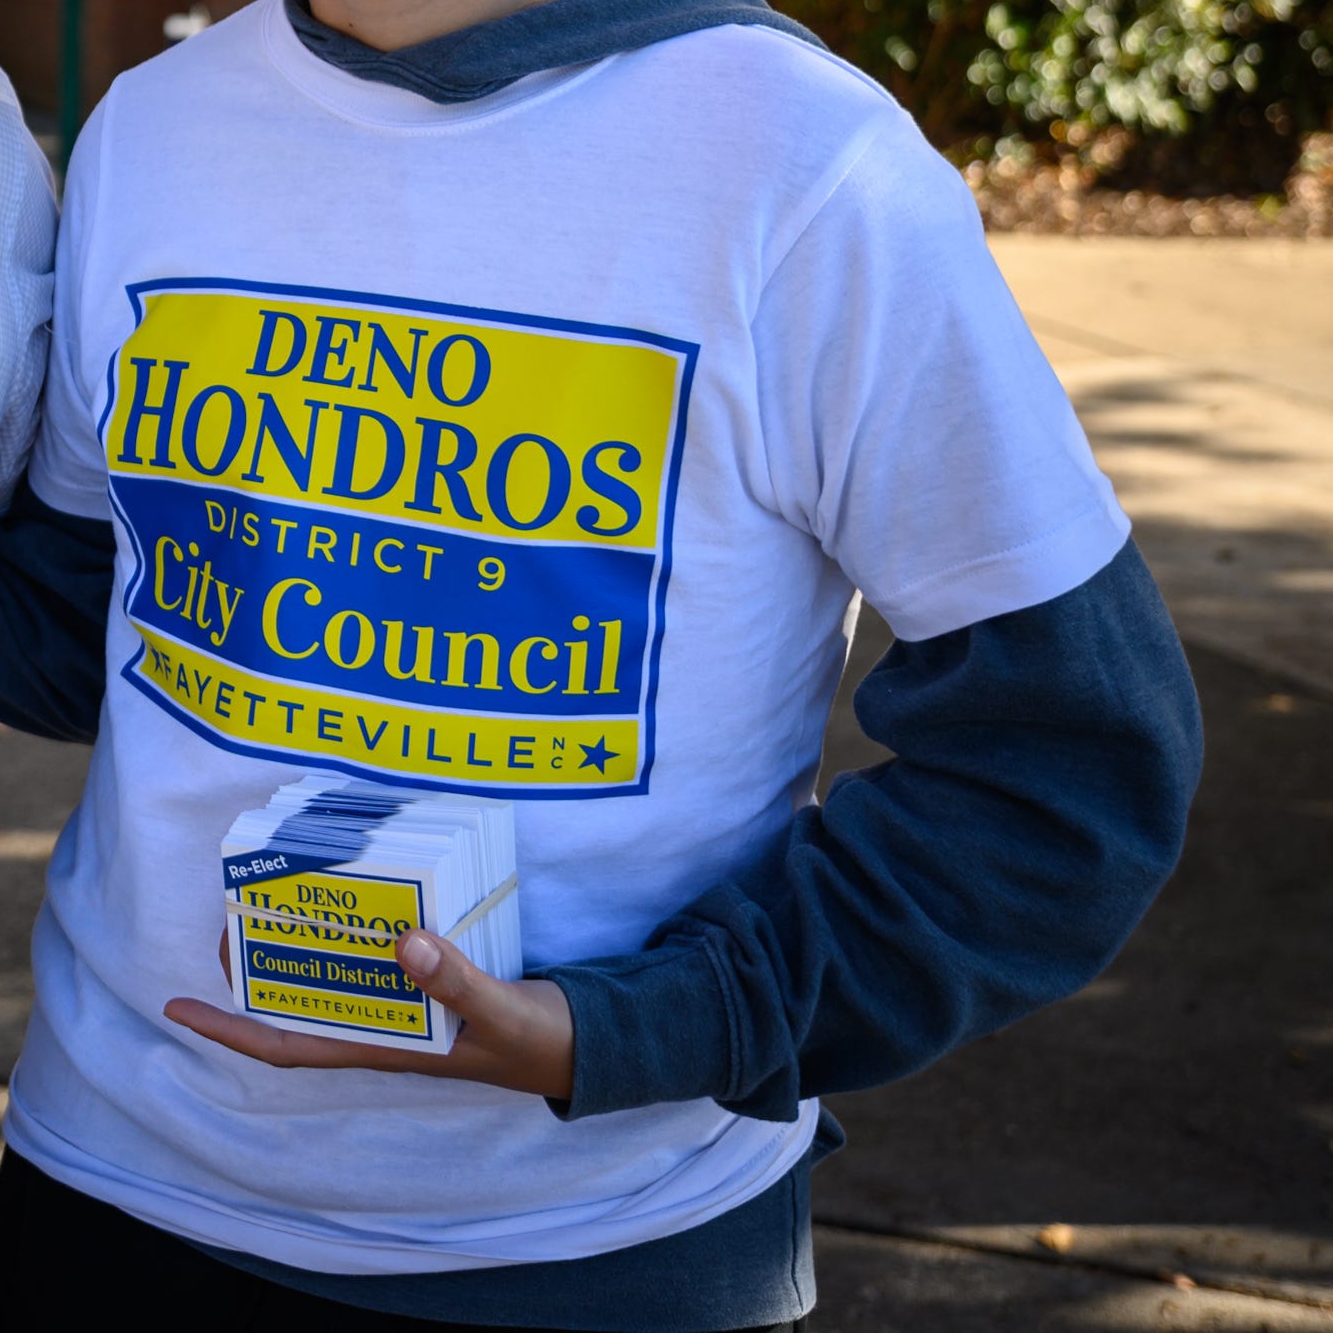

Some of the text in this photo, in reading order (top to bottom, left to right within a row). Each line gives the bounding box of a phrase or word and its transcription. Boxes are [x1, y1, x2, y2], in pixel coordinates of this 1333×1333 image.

[245, 310, 492, 408] DENO
[117, 358, 643, 537] HONDROS
[204, 500, 506, 592] DISTRICT 9
[154, 535, 623, 696] City Council
[161, 652, 536, 769] FAYETTEVILLE
[228, 854, 289, 880] Re-Elect
[296, 884, 358, 910] DENO
[252, 950, 322, 979] Council
[326, 961, 400, 991] District
[268, 990, 396, 1022] FAYETTEVILLE
